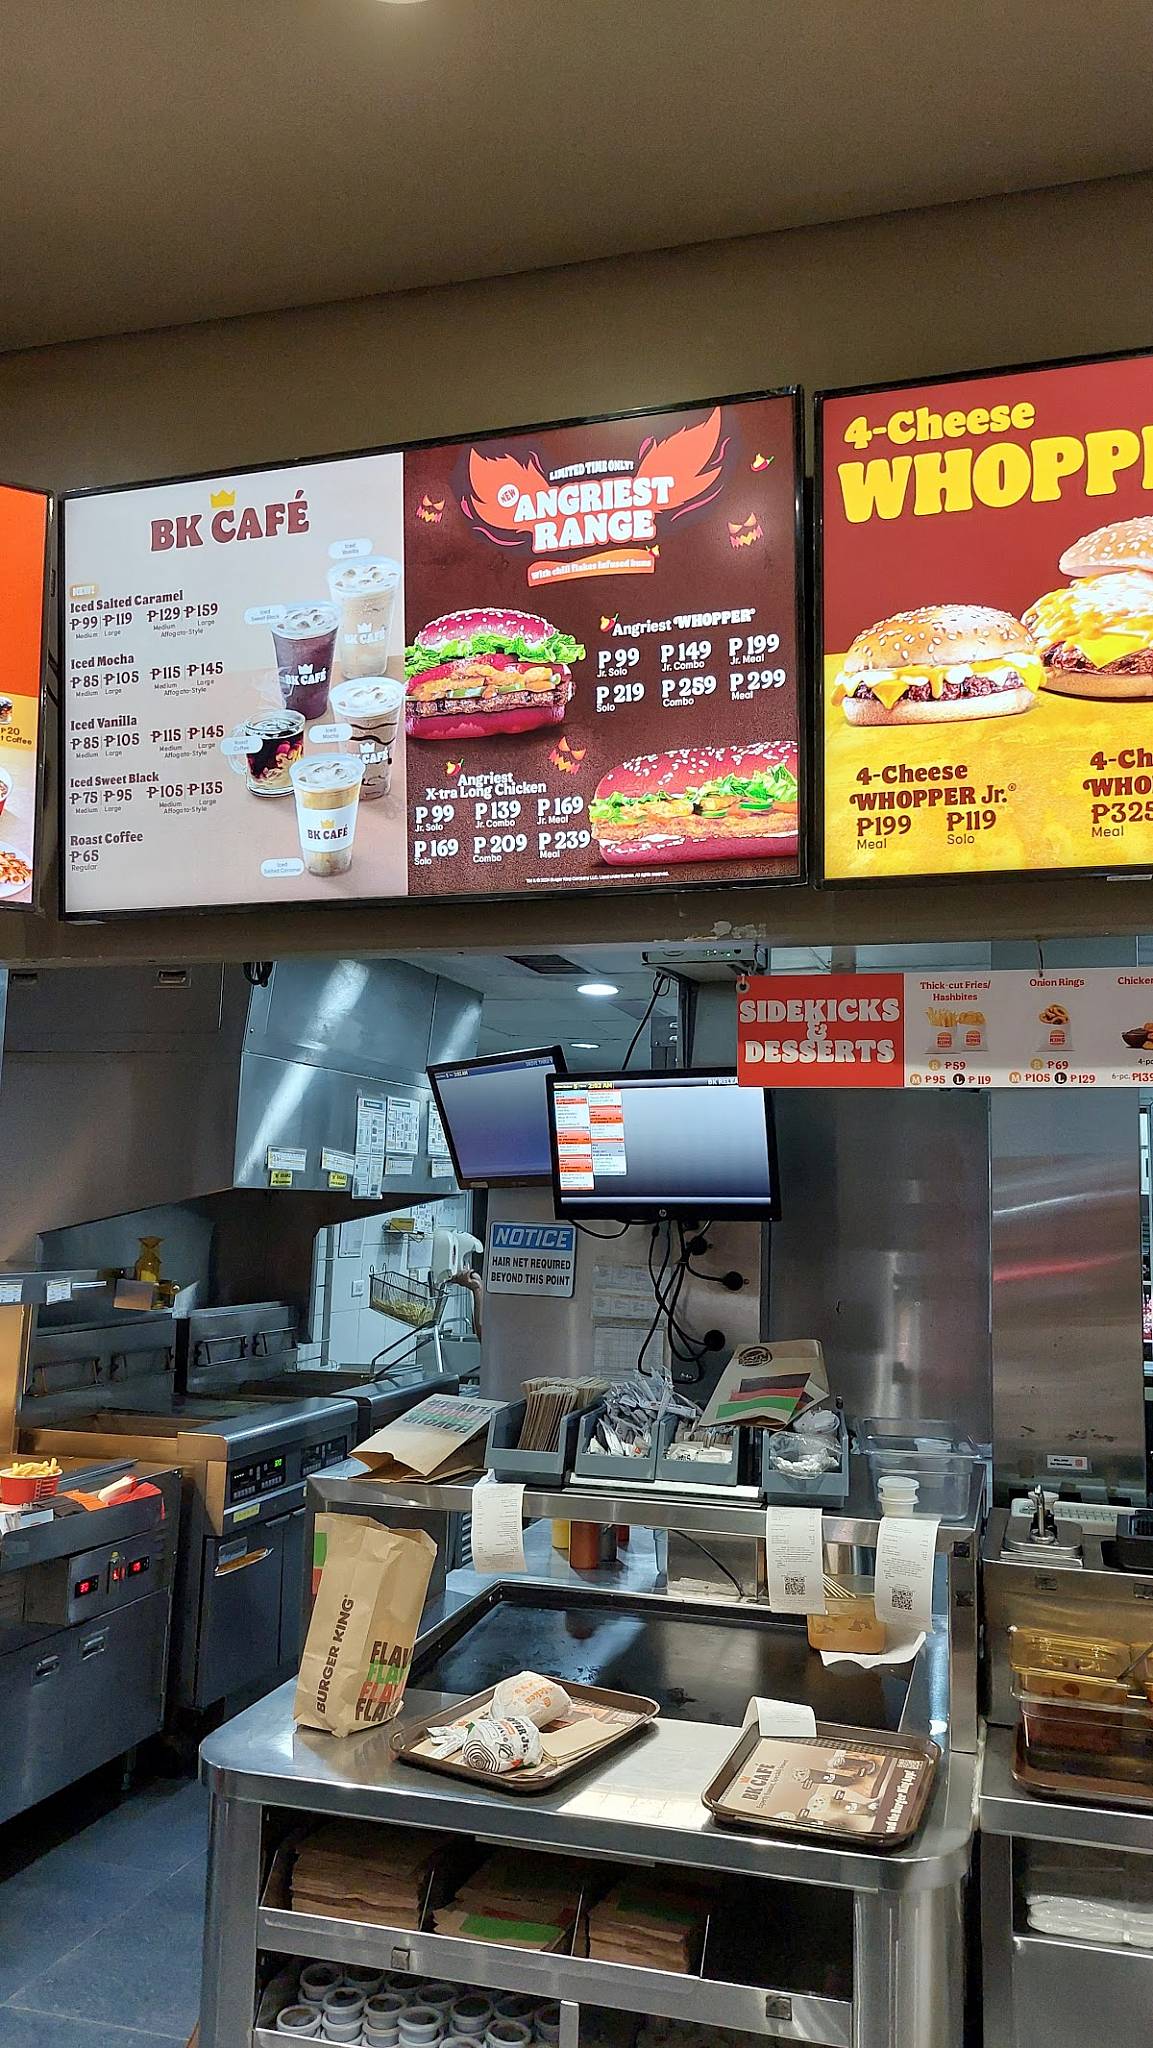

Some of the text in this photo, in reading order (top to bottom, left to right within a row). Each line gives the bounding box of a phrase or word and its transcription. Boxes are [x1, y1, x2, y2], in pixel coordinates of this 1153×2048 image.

[843, 401, 1036, 450] 4-Cheese
[549, 463, 585, 480] LIMITED
[585, 460, 607, 474] TIME
[500, 489, 516, 503] NEW
[514, 476, 675, 522] ANGRIEST
[150, 489, 310, 552] BK CAFÉ
[533, 510, 655, 551] RANGE
[70, 590, 184, 614] Iced Salted Caramel
[75, 619, 215, 640] Medium Large Medium Large
[612, 618, 672, 638] Angriest
[70, 654, 134, 670] Iced Mocha
[597, 653, 765, 678] Jr. Solo Jr. Combo Jr. Meal
[596, 691, 754, 713] Solo Combo Meal
[71, 715, 137, 731] Iced Vanilla
[6, 735, 32, 745] Coffee
[70, 772, 160, 788] Iced Sweet Black
[457, 771, 514, 788] Angriest
[856, 763, 969, 786] 4-Cheese
[425, 781, 547, 801] X-tra Long Chicken
[1083, 775, 1153, 797] WHO
[849, 786, 976, 811] WHOPPER
[307, 824, 349, 840] BK CAFÉ
[414, 815, 569, 832] Jr. Solo Jr. Combo Jr. Meal
[1091, 825, 1124, 838] Meal
[70, 831, 144, 846] Roast Coffee
[856, 833, 975, 850] Meal Solo
[414, 850, 561, 866] Solo Combo Meal
[71, 863, 98, 872] Regular
[919, 980, 991, 990] Thick-cut Fries/
[1029, 977, 1085, 988] Onion Rings
[932, 993, 978, 1001] Hashbites
[739, 998, 900, 1023] SIDEKICKS
[807, 1020, 828, 1041] &
[744, 1040, 896, 1064] DESSERTS
[495, 1227, 571, 1248] NOTICE
[492, 1256, 571, 1270] HAIR NET REQUIRED
[491, 1271, 570, 1286] BEYOND THIS POINT
[316, 1597, 355, 1714] BURGER KING
[742, 1786, 763, 1801] BK
